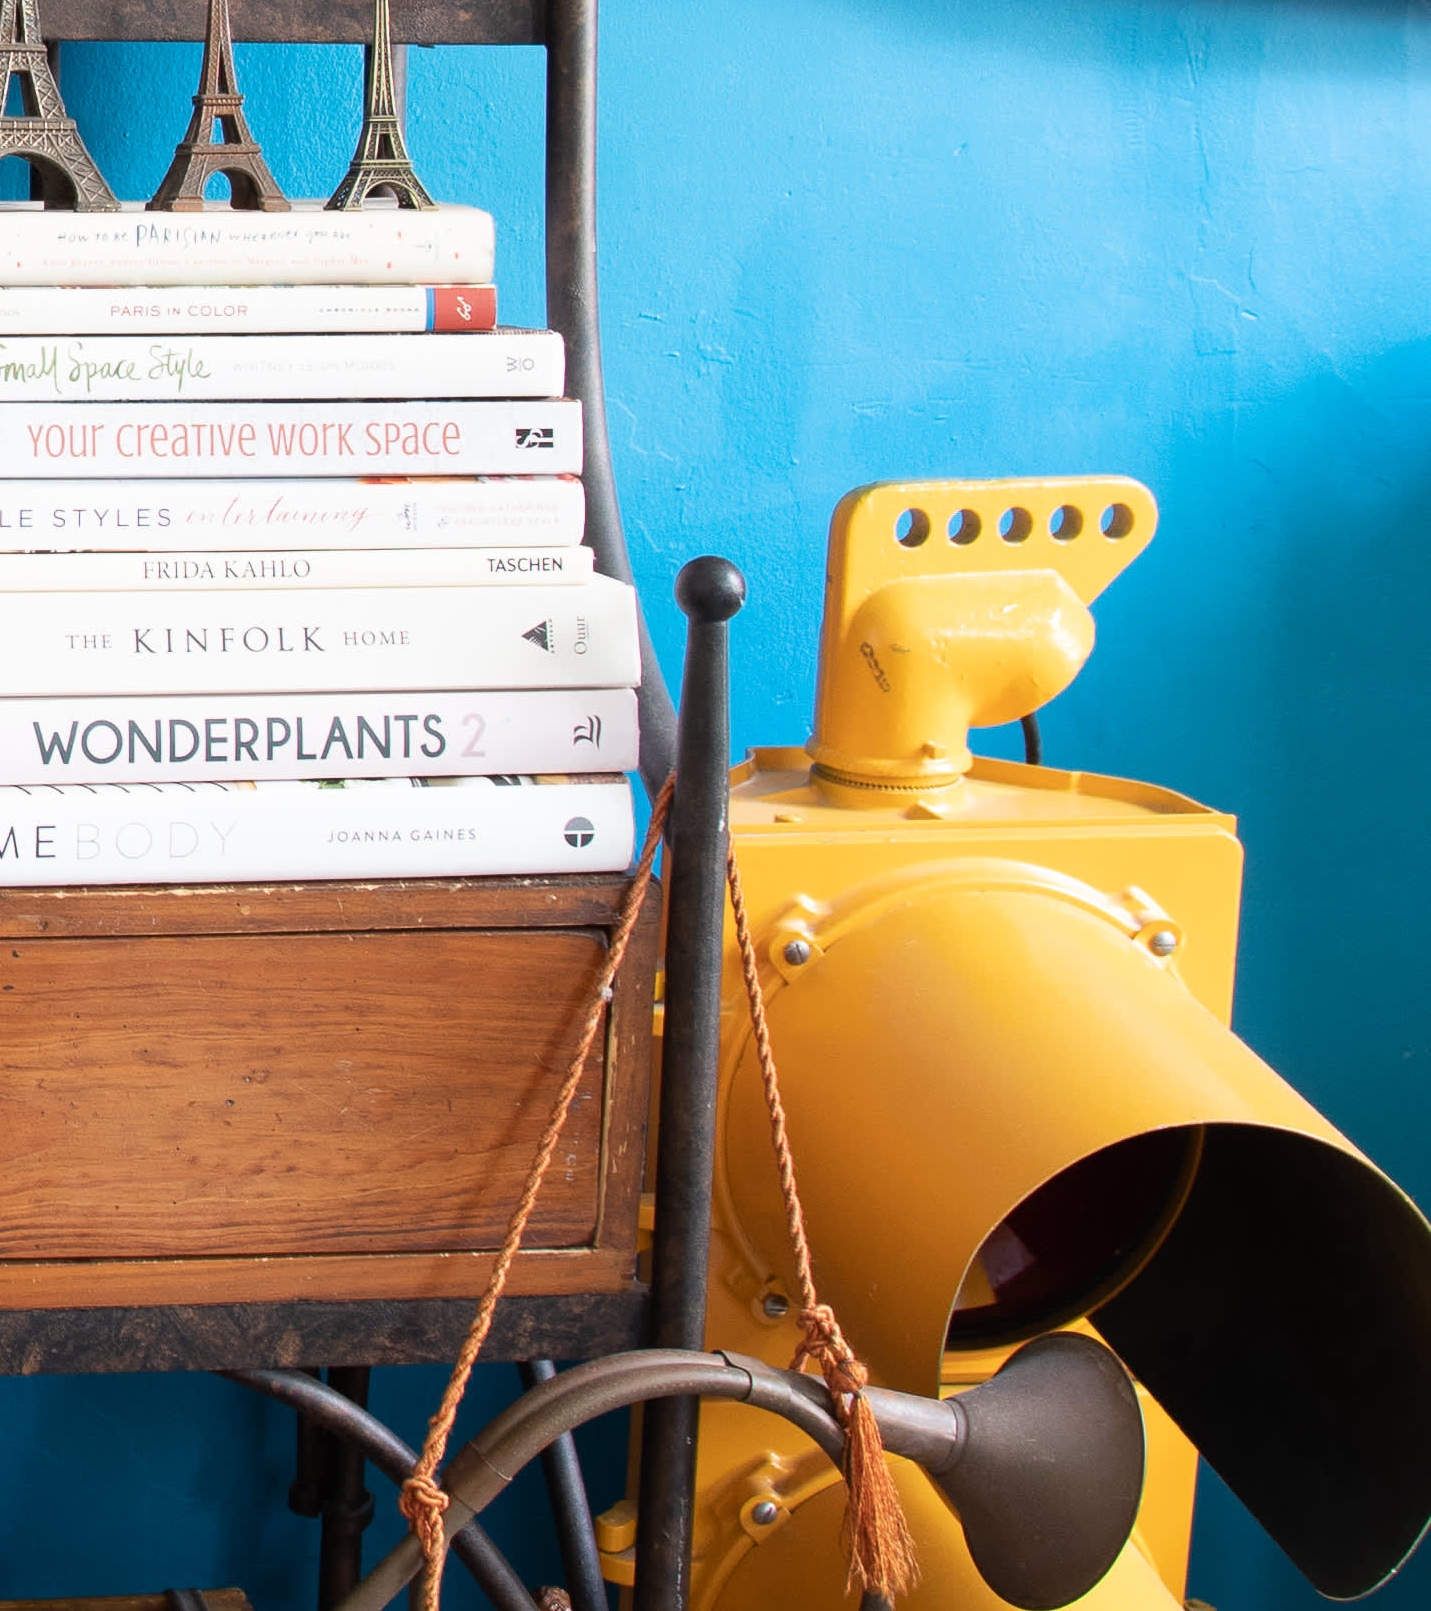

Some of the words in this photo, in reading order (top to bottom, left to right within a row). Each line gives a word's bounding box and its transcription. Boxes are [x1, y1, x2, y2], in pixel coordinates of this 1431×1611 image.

[68, 341, 141, 394] Space
[148, 344, 213, 393] Style
[53, 508, 172, 528] STYLES
[185, 494, 374, 532] entertaining
[144, 560, 214, 579] FRIDA
[224, 557, 312, 579] KAHLO
[486, 556, 564, 574] TASCHEN
[65, 634, 112, 650] THE
[133, 626, 327, 653] KINFOLK
[343, 630, 412, 646] HOME
[32, 713, 447, 765] WONDERPLANTS
[460, 712, 487, 759] 2
[327, 829, 403, 844] JOANNA
[410, 829, 477, 842] GAINES
